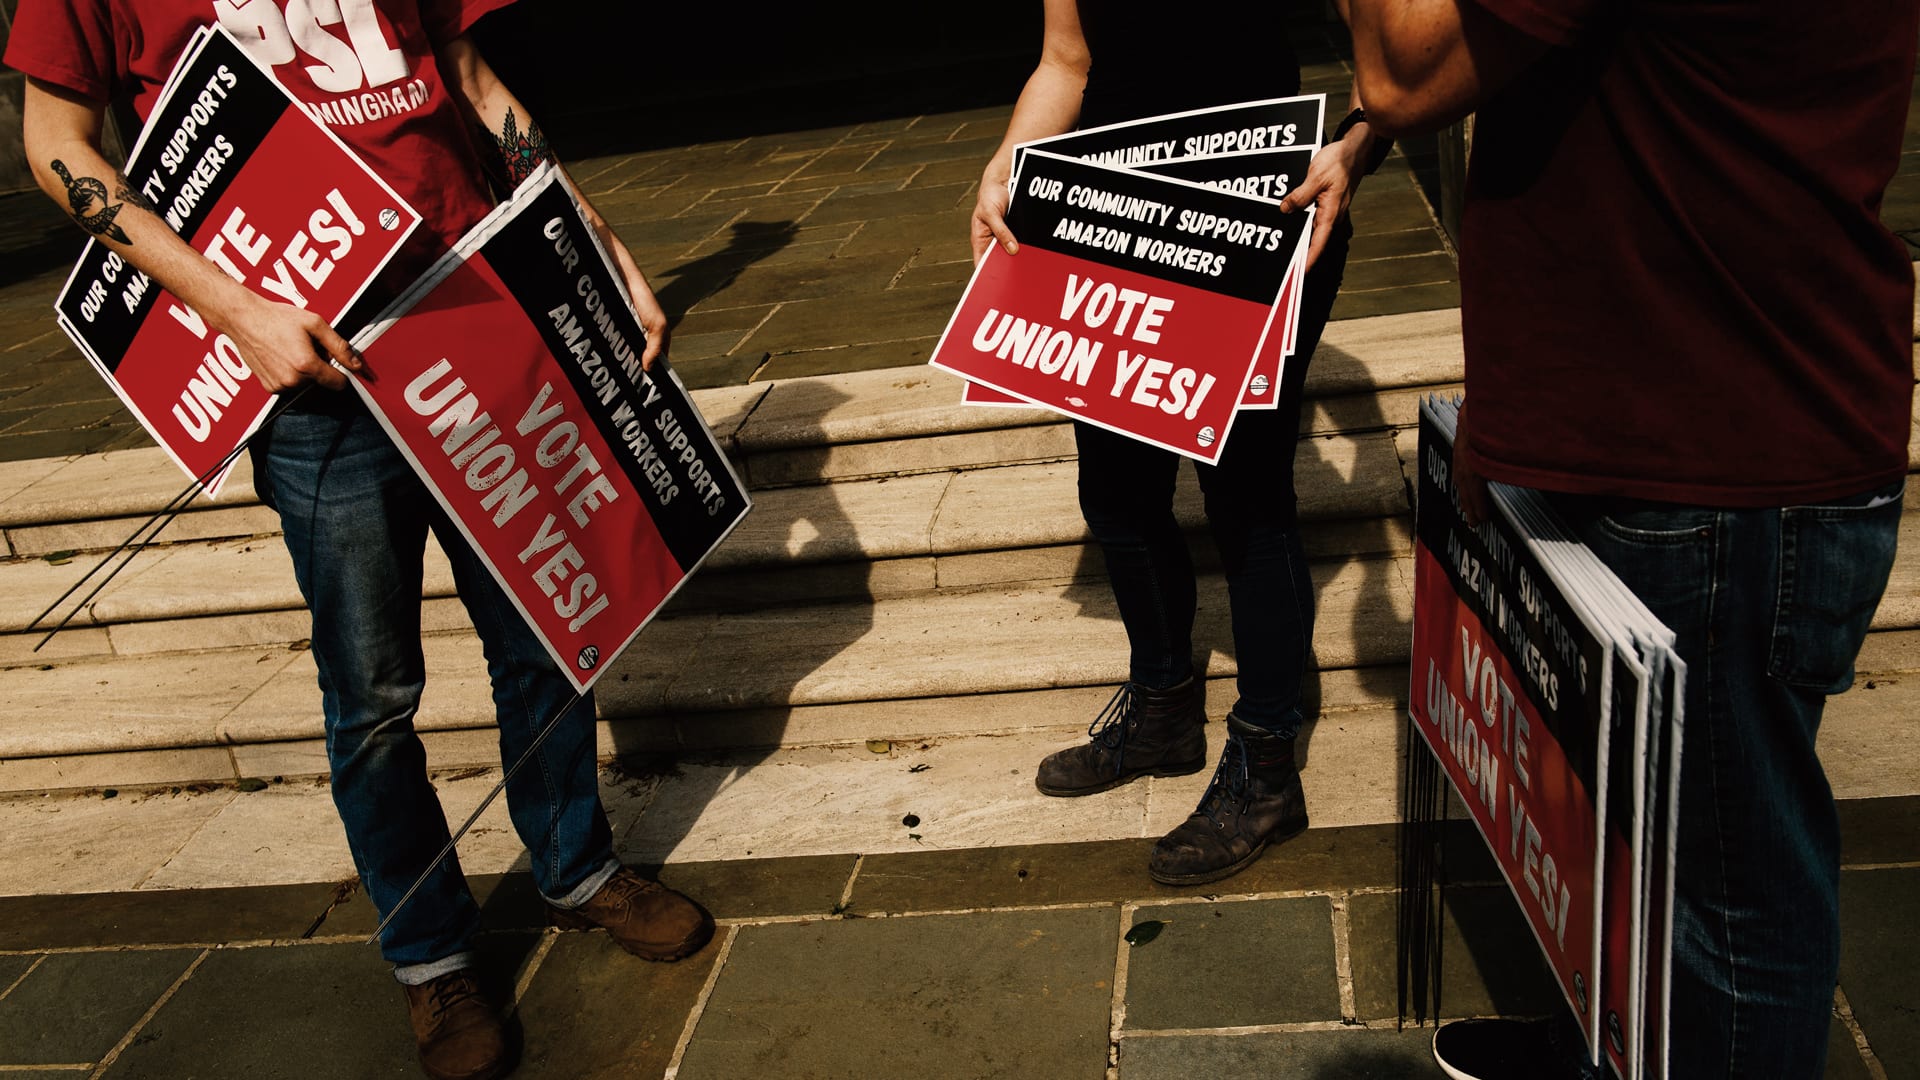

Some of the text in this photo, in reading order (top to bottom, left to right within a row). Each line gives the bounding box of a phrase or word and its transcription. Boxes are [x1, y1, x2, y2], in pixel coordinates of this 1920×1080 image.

[307, 79, 430, 125] MINGHAM
[1184, 123, 1297, 159] SUPPORTS
[80, 64, 238, 323] OUR SUPPORTS
[168, 206, 272, 339] VTE
[1028, 176, 1283, 252] OUR COMMUNITY SUPPORTS
[1053, 217, 1226, 277] AMAZON WORKERS
[171, 187, 366, 442] UNIO YES!
[543, 216, 725, 517] OUR COMMUNITY SUPPORTS
[972, 309, 1216, 421] UNION YES!
[1059, 273, 1175, 345] VOTE
[515, 381, 619, 529] VOTE
[547, 302, 680, 506] AMAZON WORKERS
[403, 357, 610, 633] UNION YES!
[1427, 444, 1447, 493] OUR
[1518, 564, 1587, 696] SUPPORTS
[1447, 528, 1559, 712] AMAZON WORKERS
[1461, 625, 1530, 792] VOTE
[1427, 656, 1571, 953] UNION YES!
